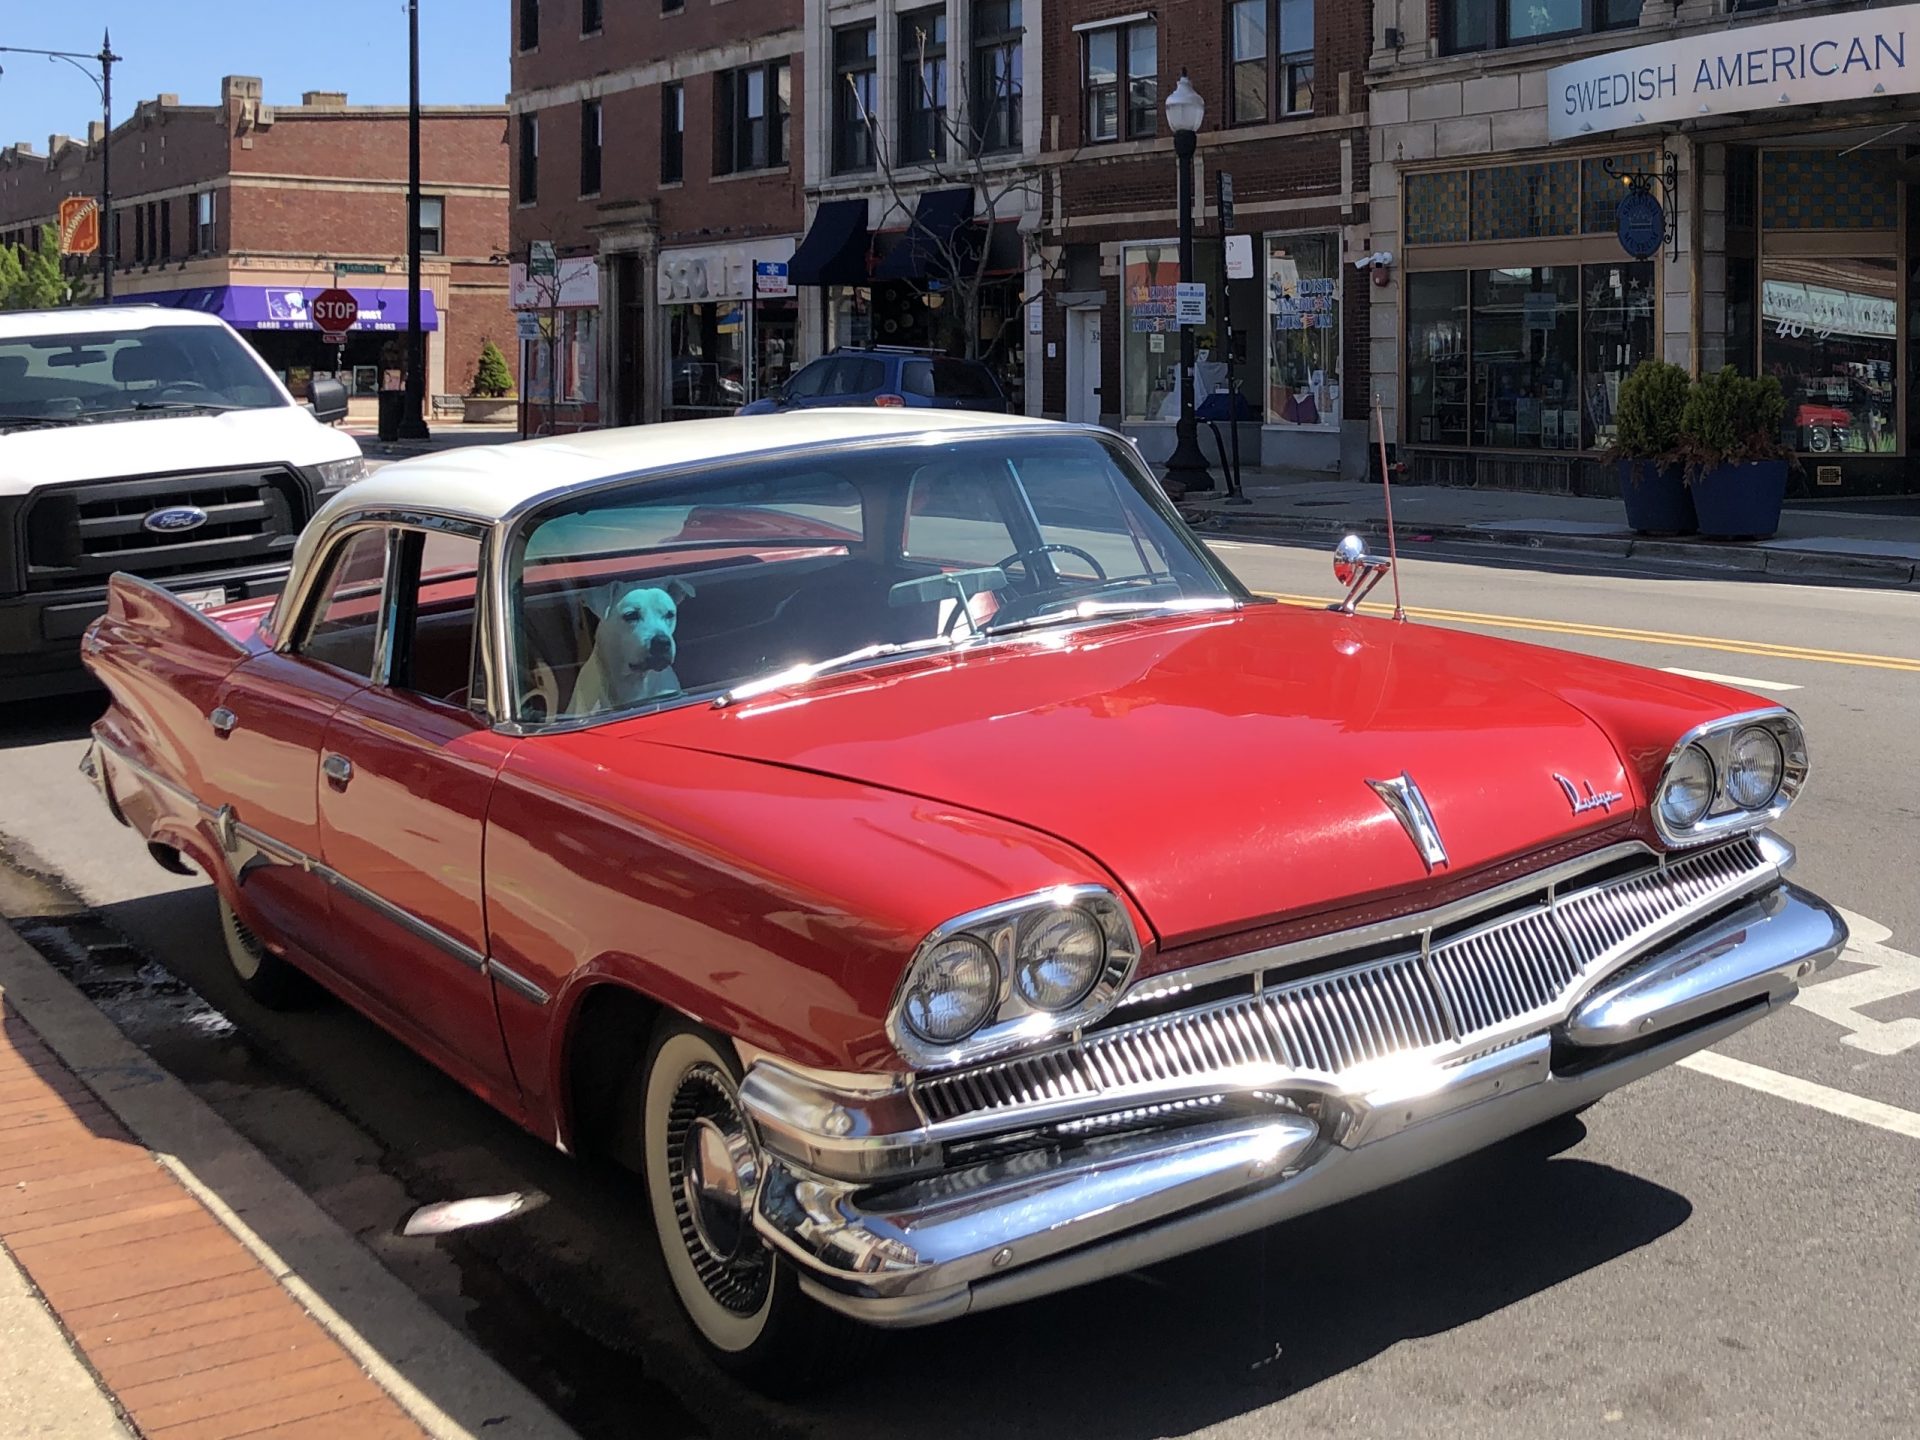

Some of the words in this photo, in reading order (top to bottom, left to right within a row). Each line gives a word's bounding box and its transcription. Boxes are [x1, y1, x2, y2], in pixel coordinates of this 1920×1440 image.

[1564, 63, 1677, 116] SWEDISH
[1692, 31, 1906, 93] AMERICAN
[315, 302, 356, 318] STOP
[160, 513, 194, 528] Ford
[1552, 772, 1623, 814] Dodge
